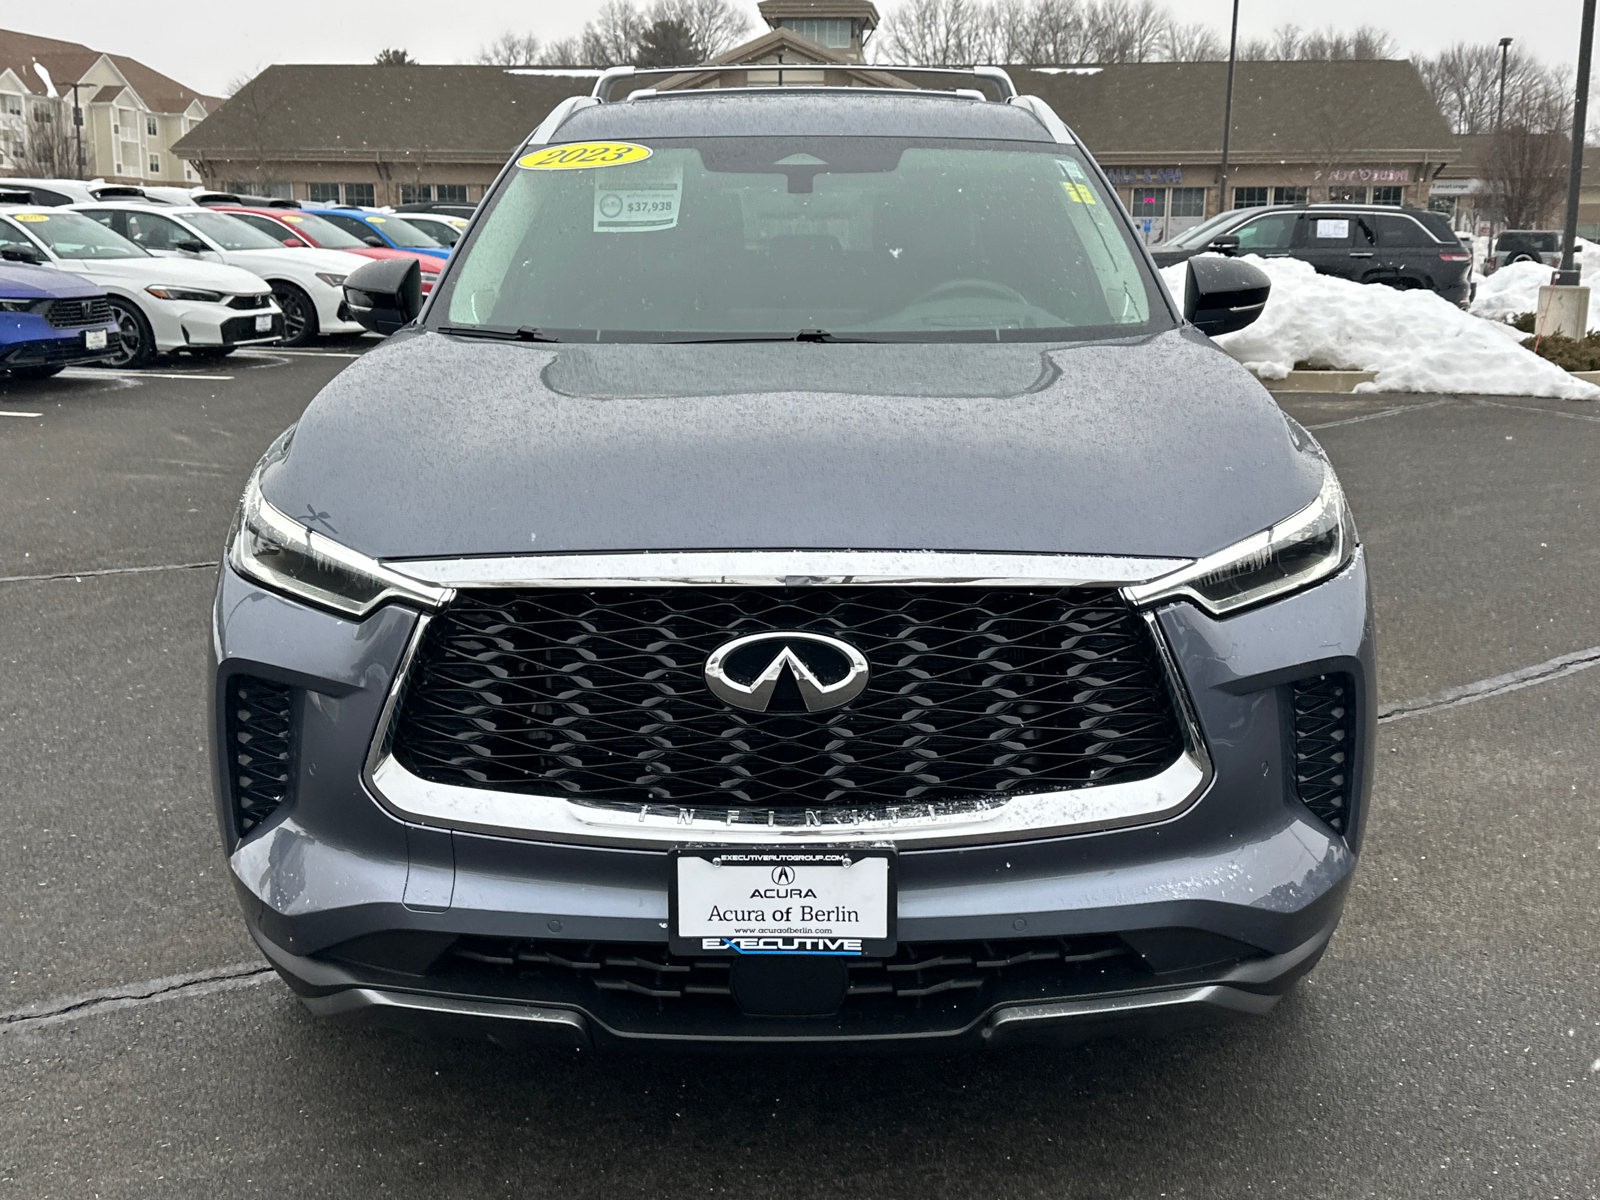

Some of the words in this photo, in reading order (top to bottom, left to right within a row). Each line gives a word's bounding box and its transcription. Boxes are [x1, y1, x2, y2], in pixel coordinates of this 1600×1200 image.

[533, 147, 633, 166] 2023
[1106, 168, 1137, 183] AILS
[1157, 168, 1182, 182] SPA
[627, 201, 672, 213] $37,938
[638, 804, 938, 827] INFINITI
[750, 888, 817, 899] ACURA
[707, 905, 766, 922] Acura
[772, 906, 792, 922] of
[800, 905, 860, 922] Berlin
[702, 938, 862, 950] EXECUTIVE
